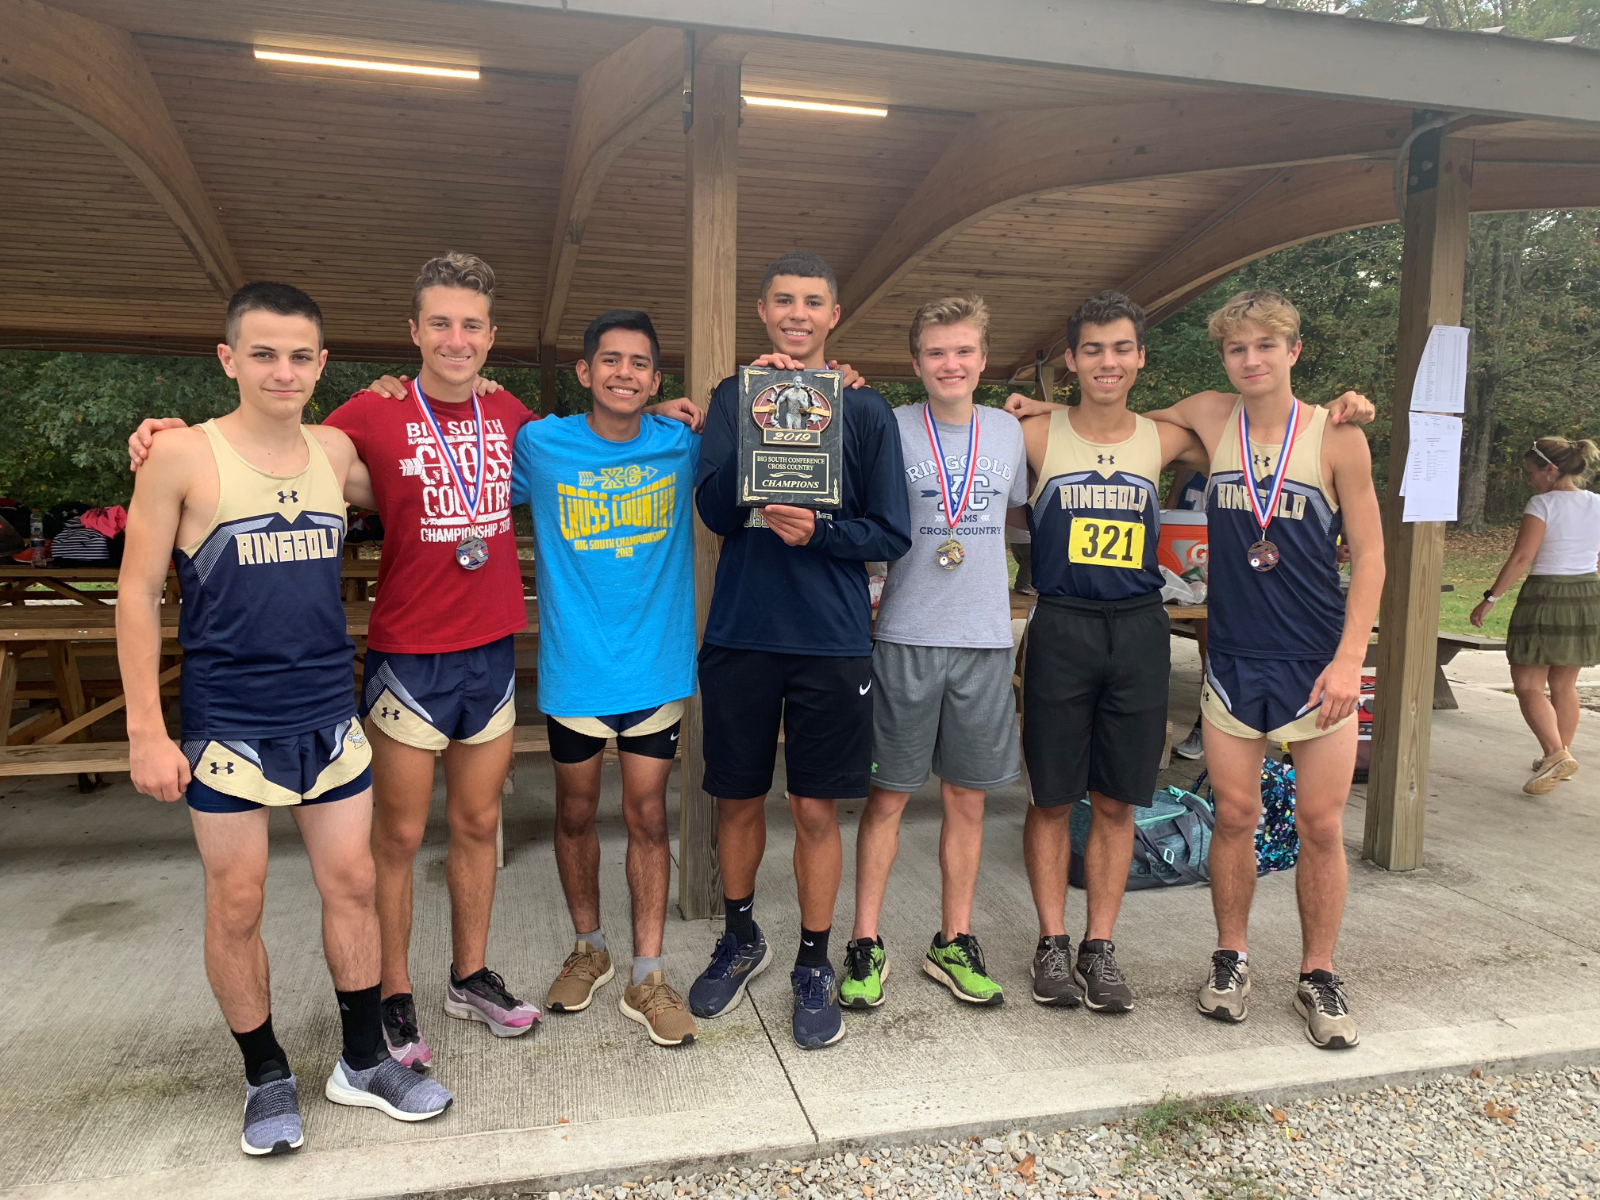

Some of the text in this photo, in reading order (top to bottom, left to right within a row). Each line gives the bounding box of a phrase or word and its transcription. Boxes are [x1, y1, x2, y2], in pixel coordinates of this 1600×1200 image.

[773, 431, 811, 442] 2019
[756, 455, 768, 463] BIG
[788, 457, 825, 465] CONFERENCE
[762, 479, 820, 489] CHAMPIONS
[1059, 485, 1148, 513] RINGGOLD
[1217, 483, 1307, 520] RINGLD
[919, 526, 1002, 536] CROSS COUNTRY
[233, 528, 340, 566] RINGGOLD
[574, 540, 589, 551] BIG
[589, 538, 615, 550] SOUTH
[1081, 523, 1133, 562] 321
[615, 546, 634, 558] 2019
[1190, 544, 1209, 565] G
